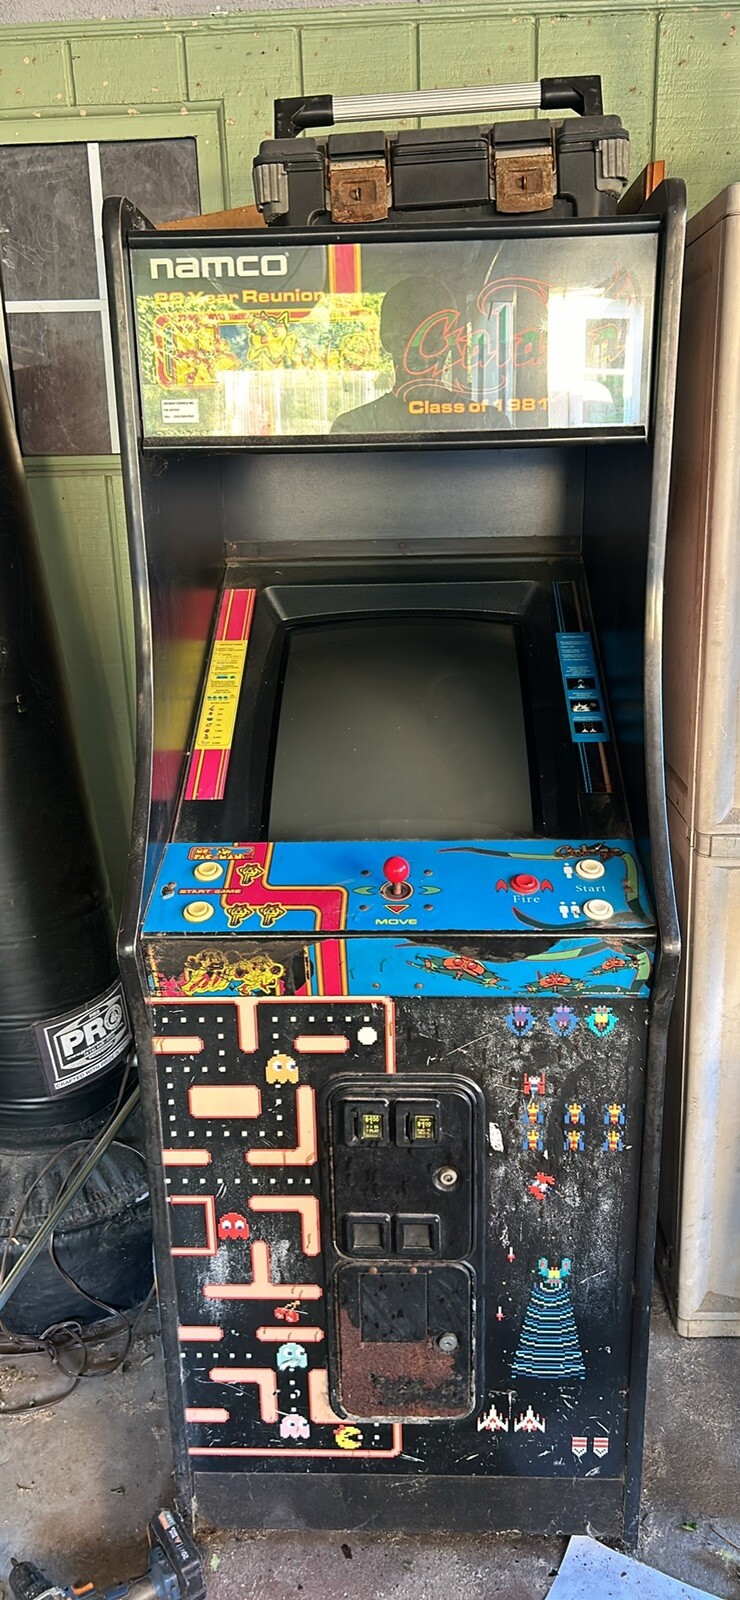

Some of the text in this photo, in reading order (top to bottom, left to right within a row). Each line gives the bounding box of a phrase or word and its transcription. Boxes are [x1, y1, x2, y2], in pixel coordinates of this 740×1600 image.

[150, 254, 288, 279] namco
[187, 290, 239, 304] Year
[242, 288, 325, 303] Reunion
[408, 398, 549, 415] Class of 1981
[575, 884, 606, 893] Start
[512, 894, 541, 904] Fire
[375, 918, 418, 926] MOVE
[60, 1003, 122, 1058] PRO
[55, 1072, 85, 1088] CRAFTED
